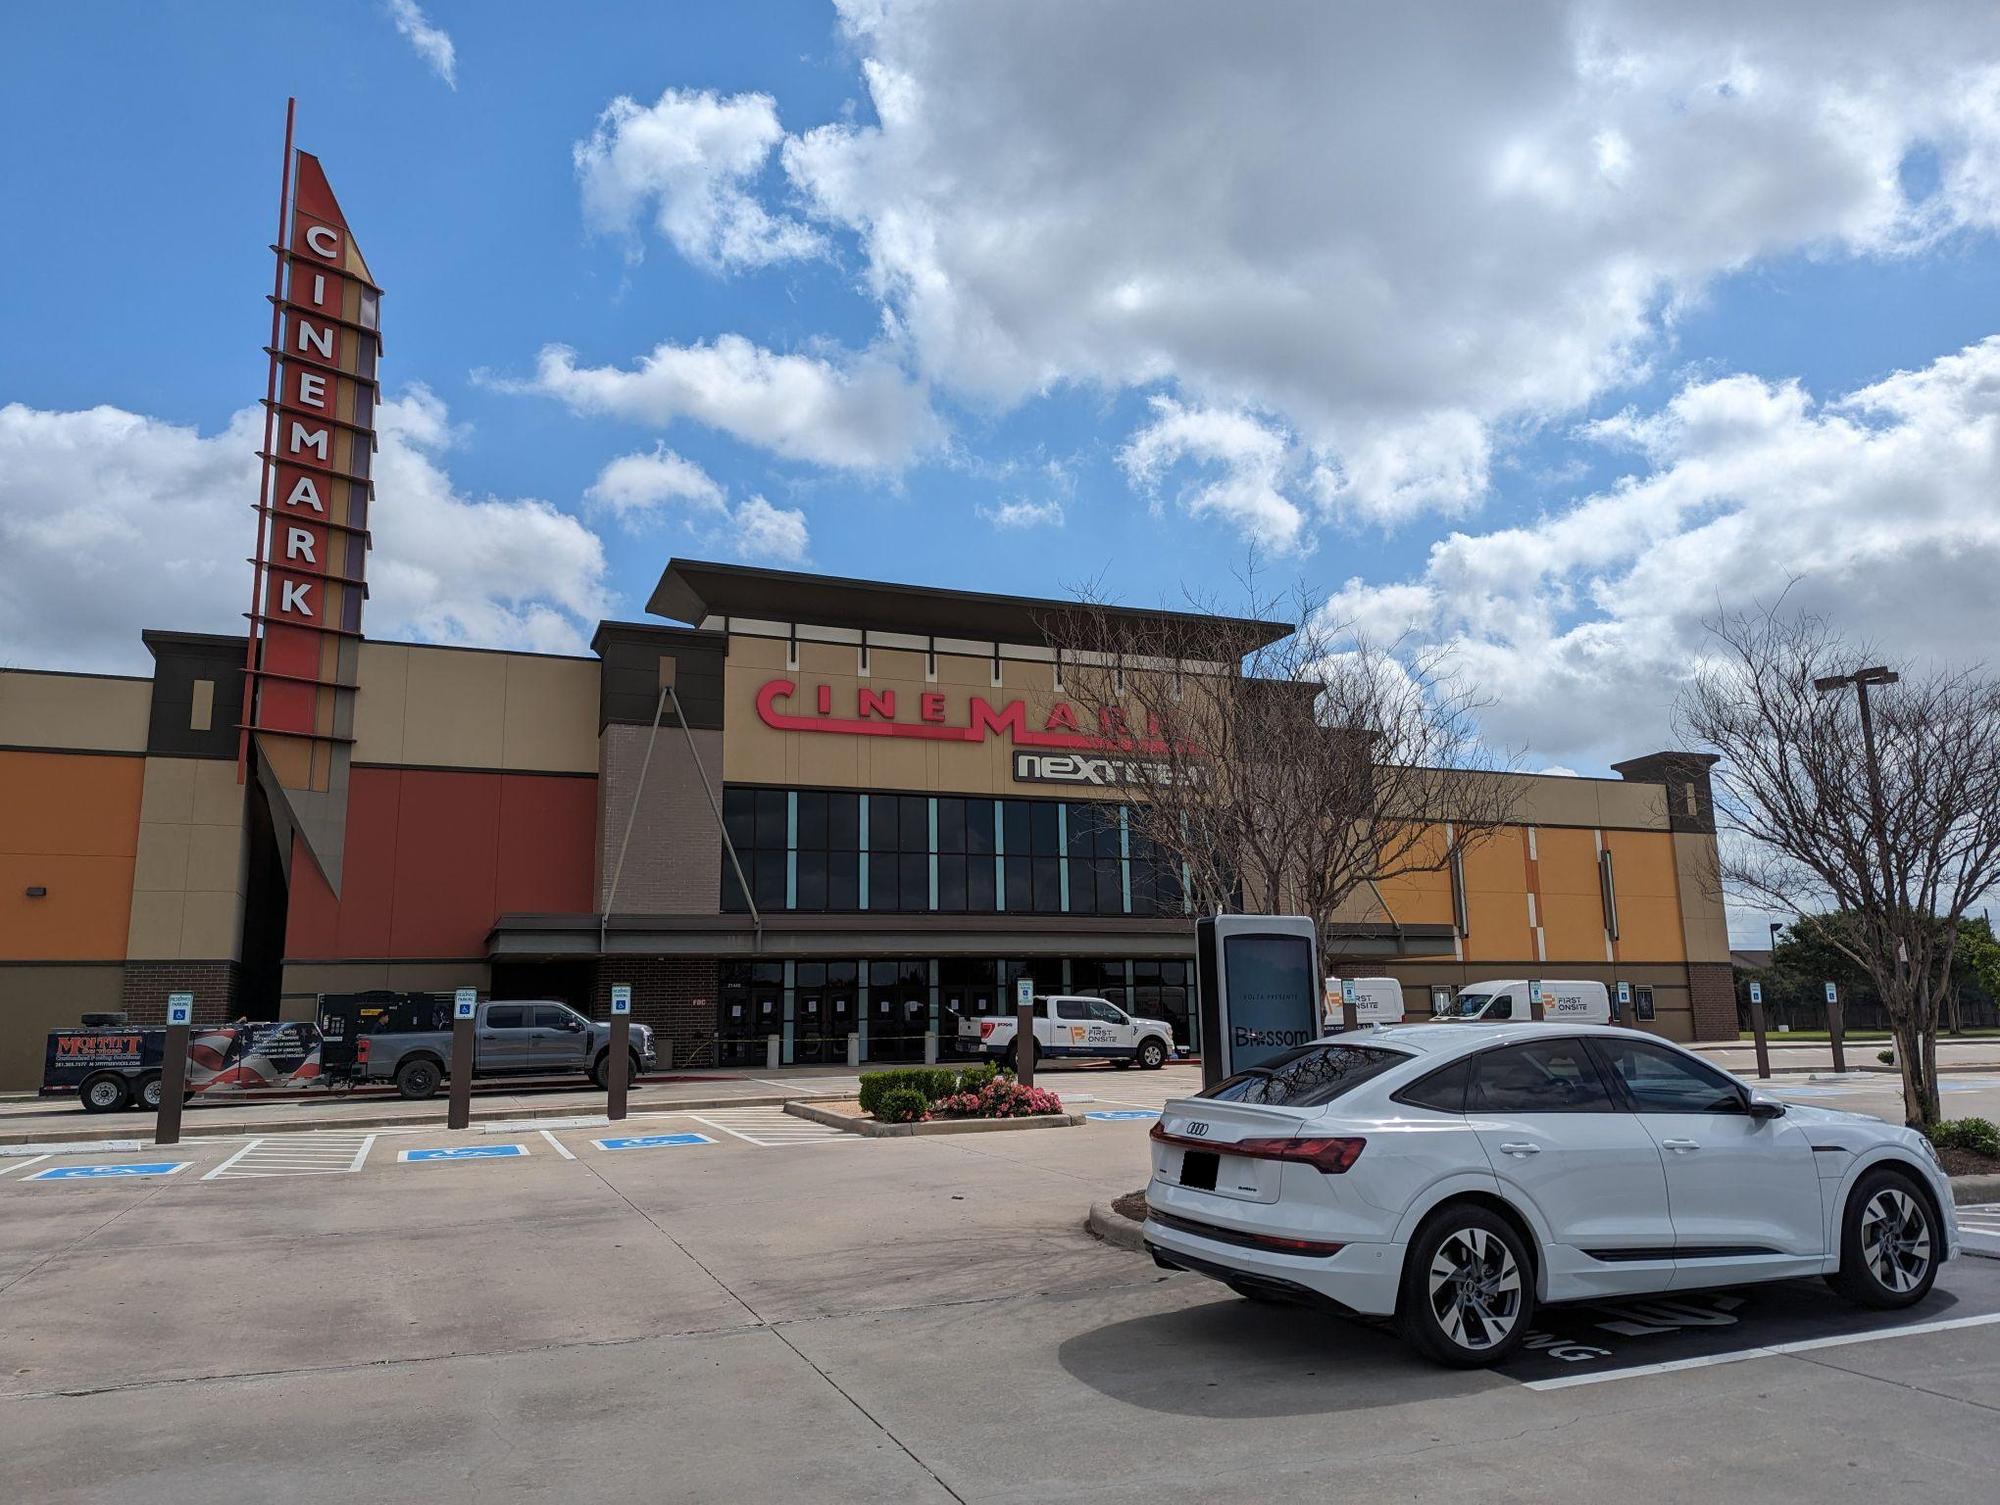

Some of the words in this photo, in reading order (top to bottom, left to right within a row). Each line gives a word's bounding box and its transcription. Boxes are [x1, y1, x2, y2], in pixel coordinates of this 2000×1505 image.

[281, 225, 338, 617] CINEMARK
[1558, 996, 1582, 1004] FIRST
[1355, 1002, 1379, 1010] NSITE
[1558, 1003, 1588, 1011] ONSITE
[1088, 1035, 1117, 1043] ONSITE
